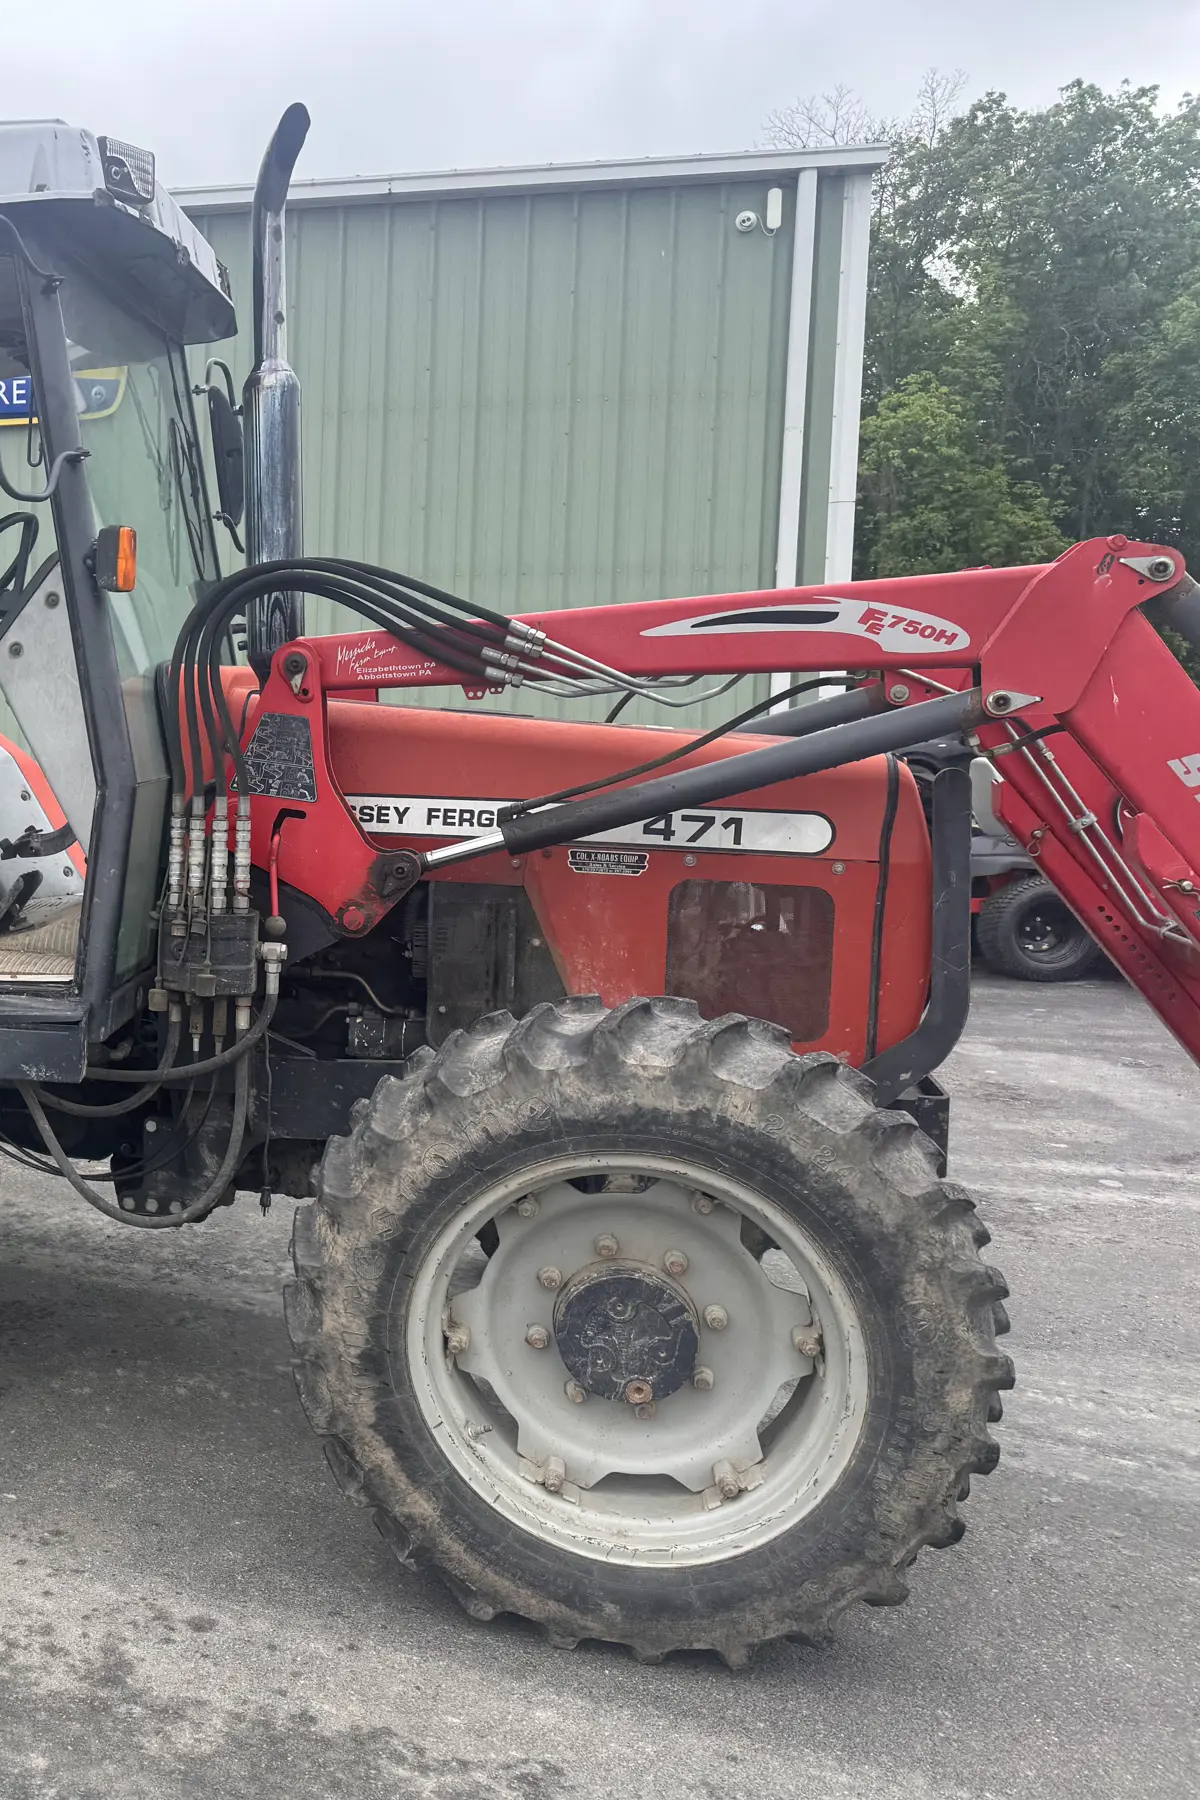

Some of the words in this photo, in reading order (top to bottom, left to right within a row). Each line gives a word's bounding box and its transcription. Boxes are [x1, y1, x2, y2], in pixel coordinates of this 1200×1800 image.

[356, 664, 422, 674] Elizabethtown
[424, 661, 437, 669] PA
[357, 671, 416, 681] Abbottstown
[418, 669, 432, 677] PA
[642, 812, 744, 846] 471
